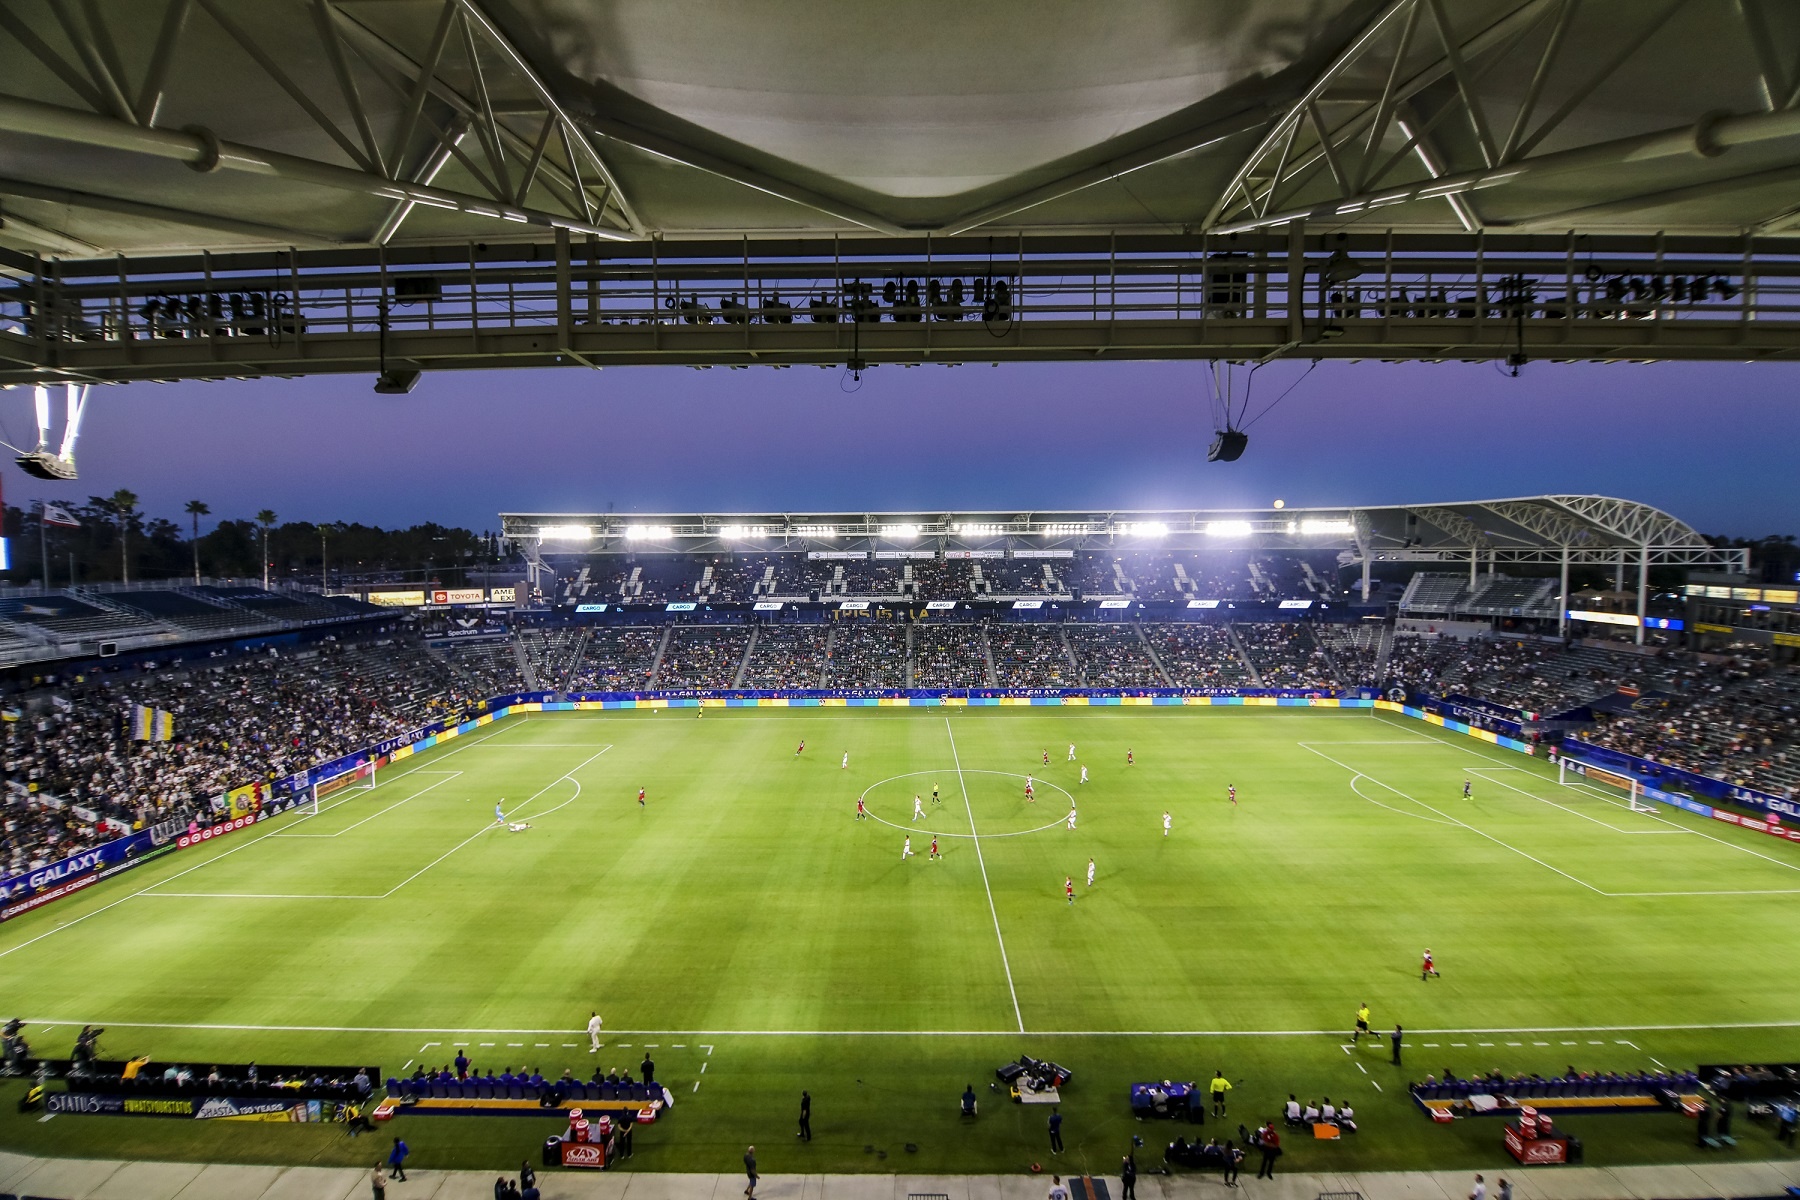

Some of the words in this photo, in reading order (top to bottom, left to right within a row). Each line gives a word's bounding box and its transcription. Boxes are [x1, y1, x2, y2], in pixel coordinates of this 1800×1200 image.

[909, 608, 929, 620] LA
[447, 629, 478, 637] Spectrum
[381, 740, 392, 753] LA
[29, 850, 103, 888] GALAXY
[8, 902, 29, 915] SAN
[29, 888, 66, 907] MANUEL
[47, 1095, 100, 1112] STATUS
[200, 1106, 234, 1118] SHASTA
[254, 1103, 284, 1113] YEARS
